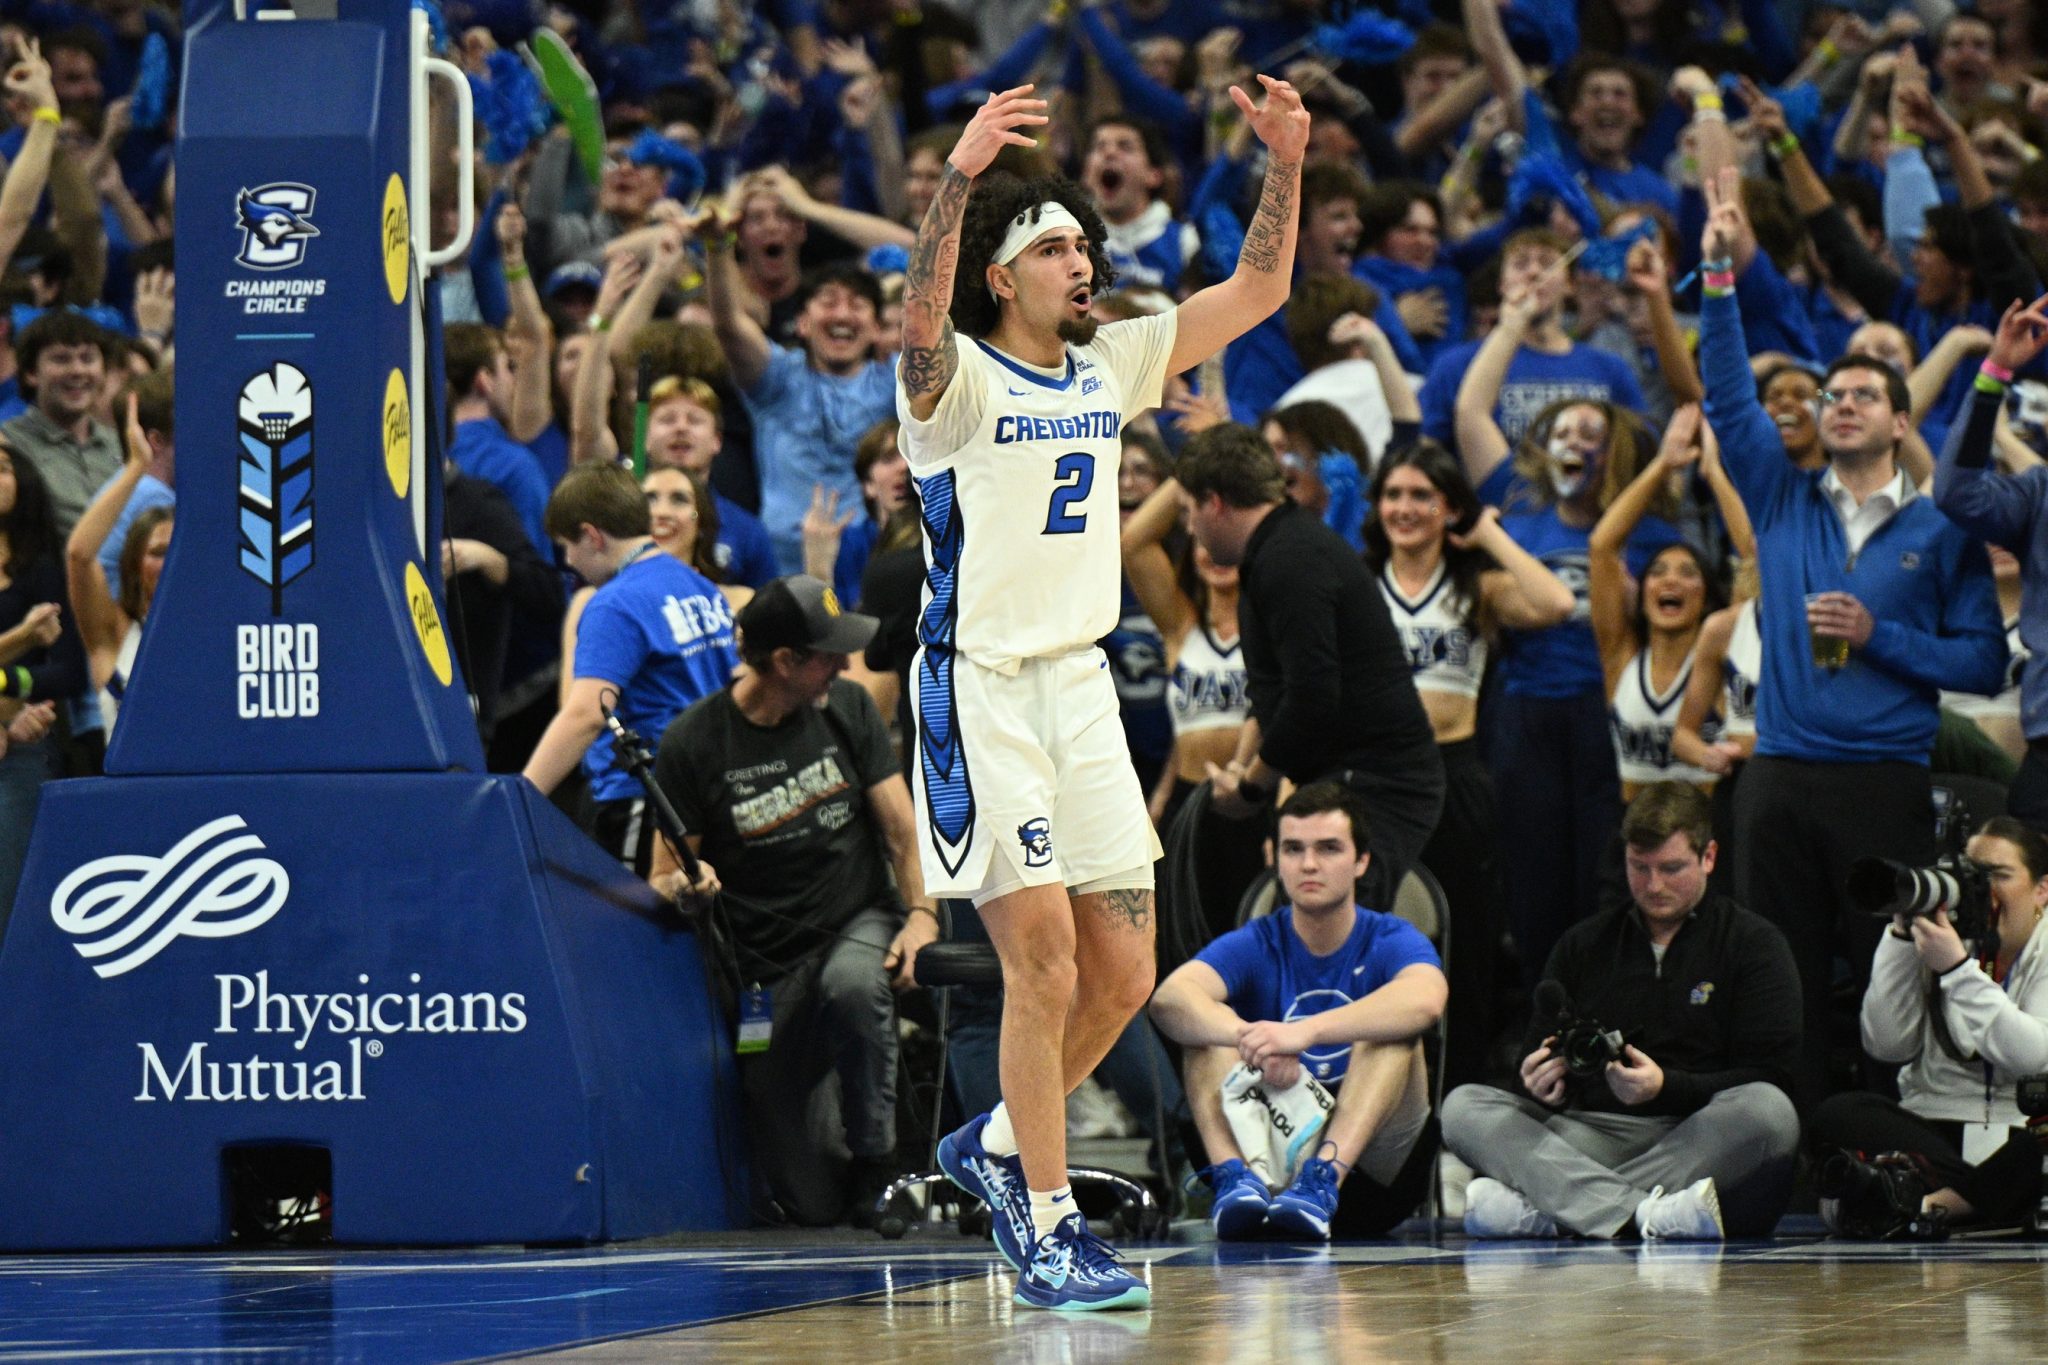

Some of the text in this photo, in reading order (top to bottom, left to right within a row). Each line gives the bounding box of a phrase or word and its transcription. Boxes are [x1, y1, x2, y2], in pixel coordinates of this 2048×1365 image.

[226, 280, 326, 296] CHAMPIONS
[245, 298, 306, 313] CIRCLE
[994, 411, 1121, 444] CREIGHTON
[1040, 452, 1095, 535] 2
[237, 623, 319, 672] BIRD
[238, 671, 320, 718] CLUB
[724, 760, 788, 782] GREETINGS
[213, 969, 528, 1050] Physicians
